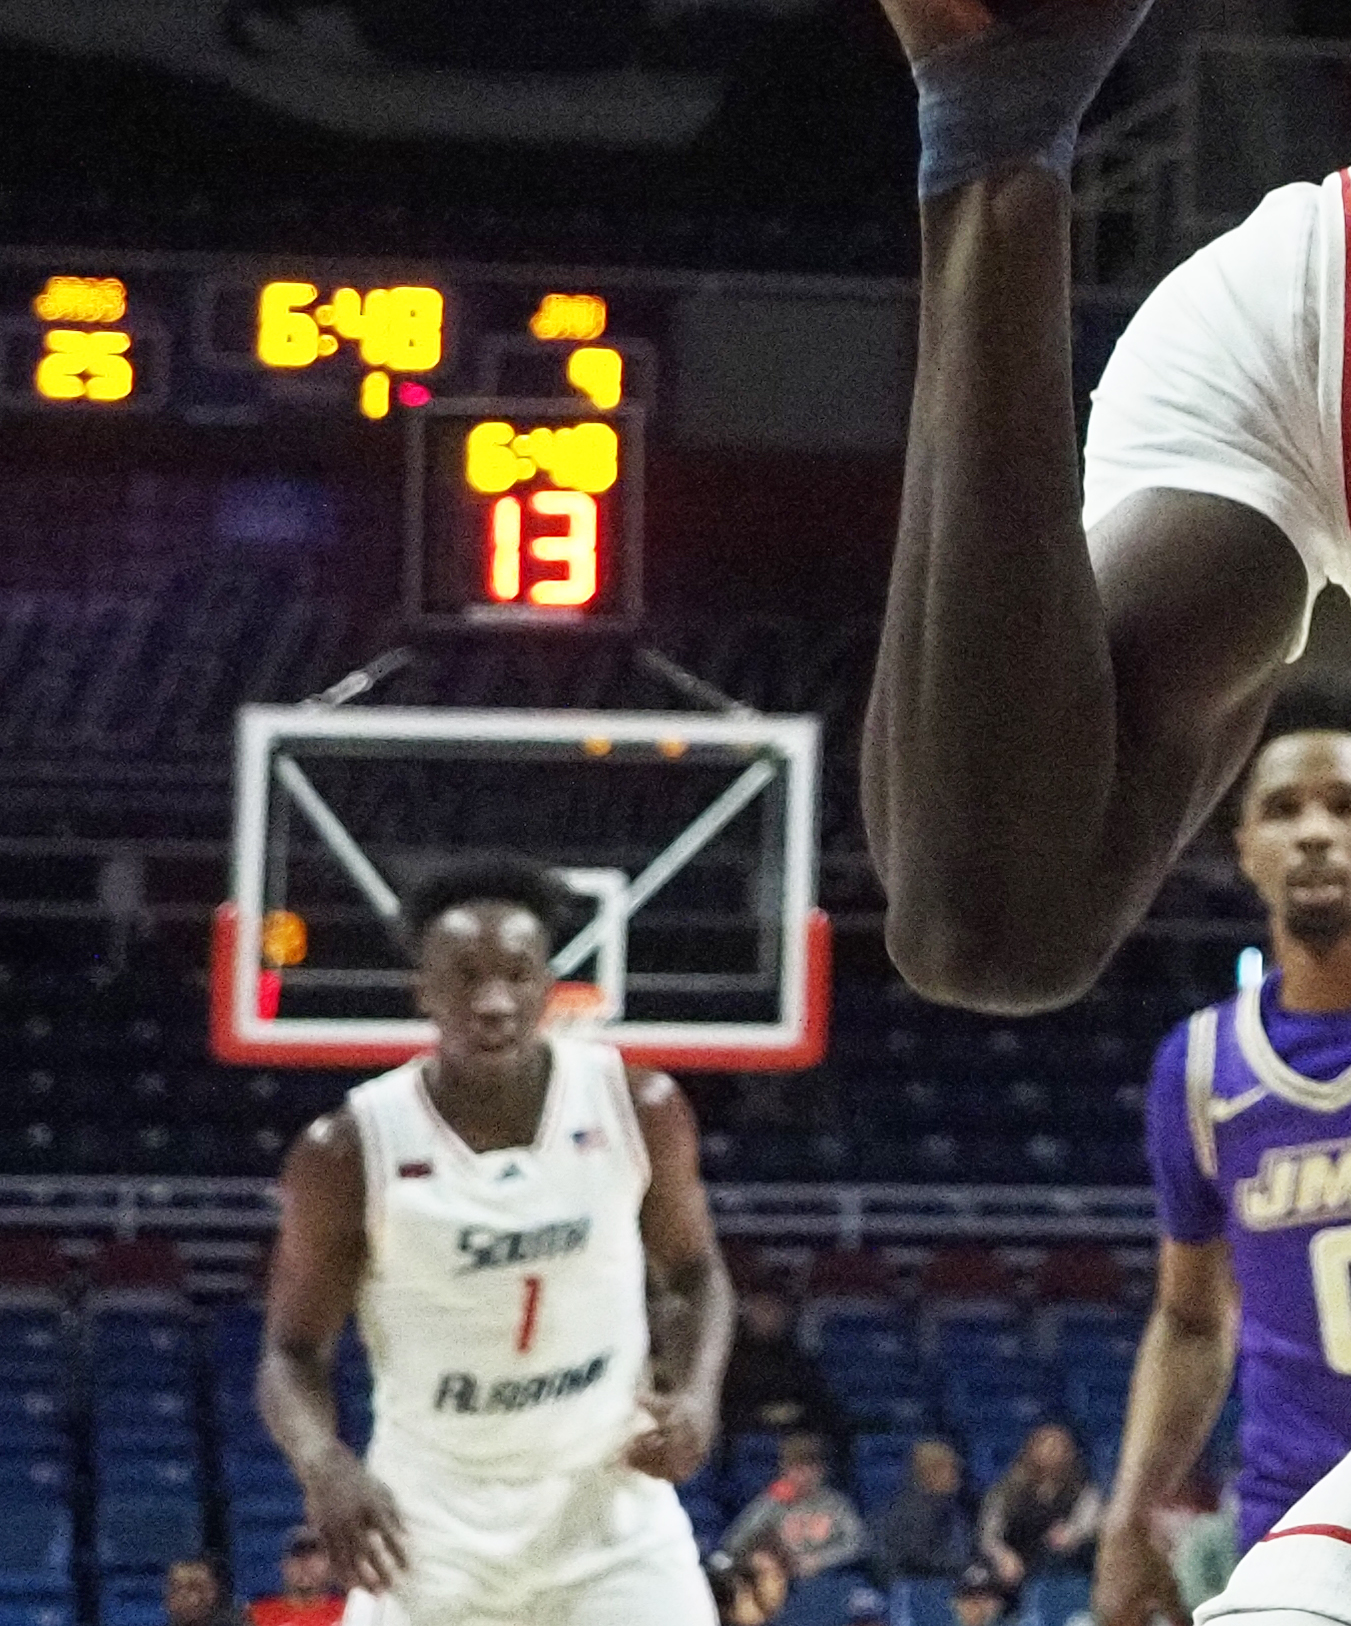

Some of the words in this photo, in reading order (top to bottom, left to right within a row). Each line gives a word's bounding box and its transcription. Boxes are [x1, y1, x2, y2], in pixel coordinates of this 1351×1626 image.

[260, 282, 444, 371] 6:48
[490, 489, 598, 606] 13
[514, 1276, 541, 1354] 1
